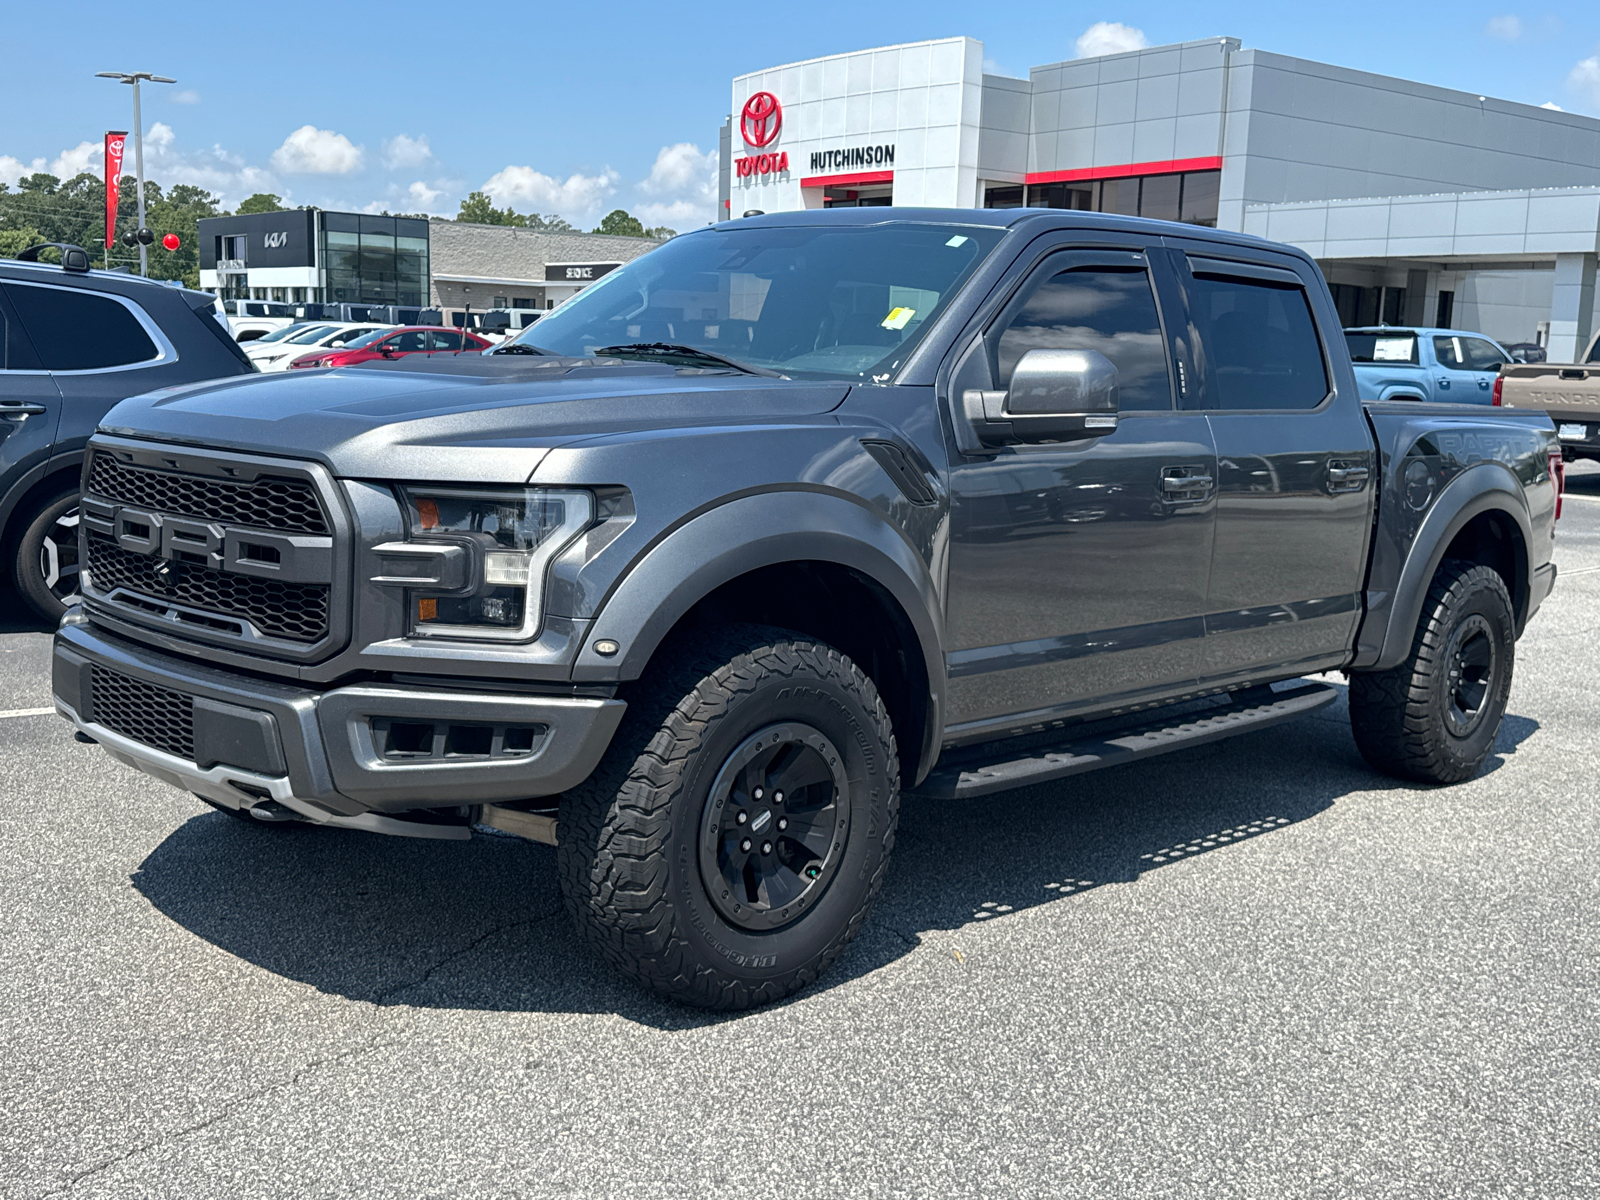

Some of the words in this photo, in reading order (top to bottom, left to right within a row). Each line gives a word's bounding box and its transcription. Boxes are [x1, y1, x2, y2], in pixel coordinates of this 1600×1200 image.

[734, 151, 789, 178] TOYOTA
[810, 144, 895, 170] HUTCHINSON
[80, 498, 304, 583] FORD
